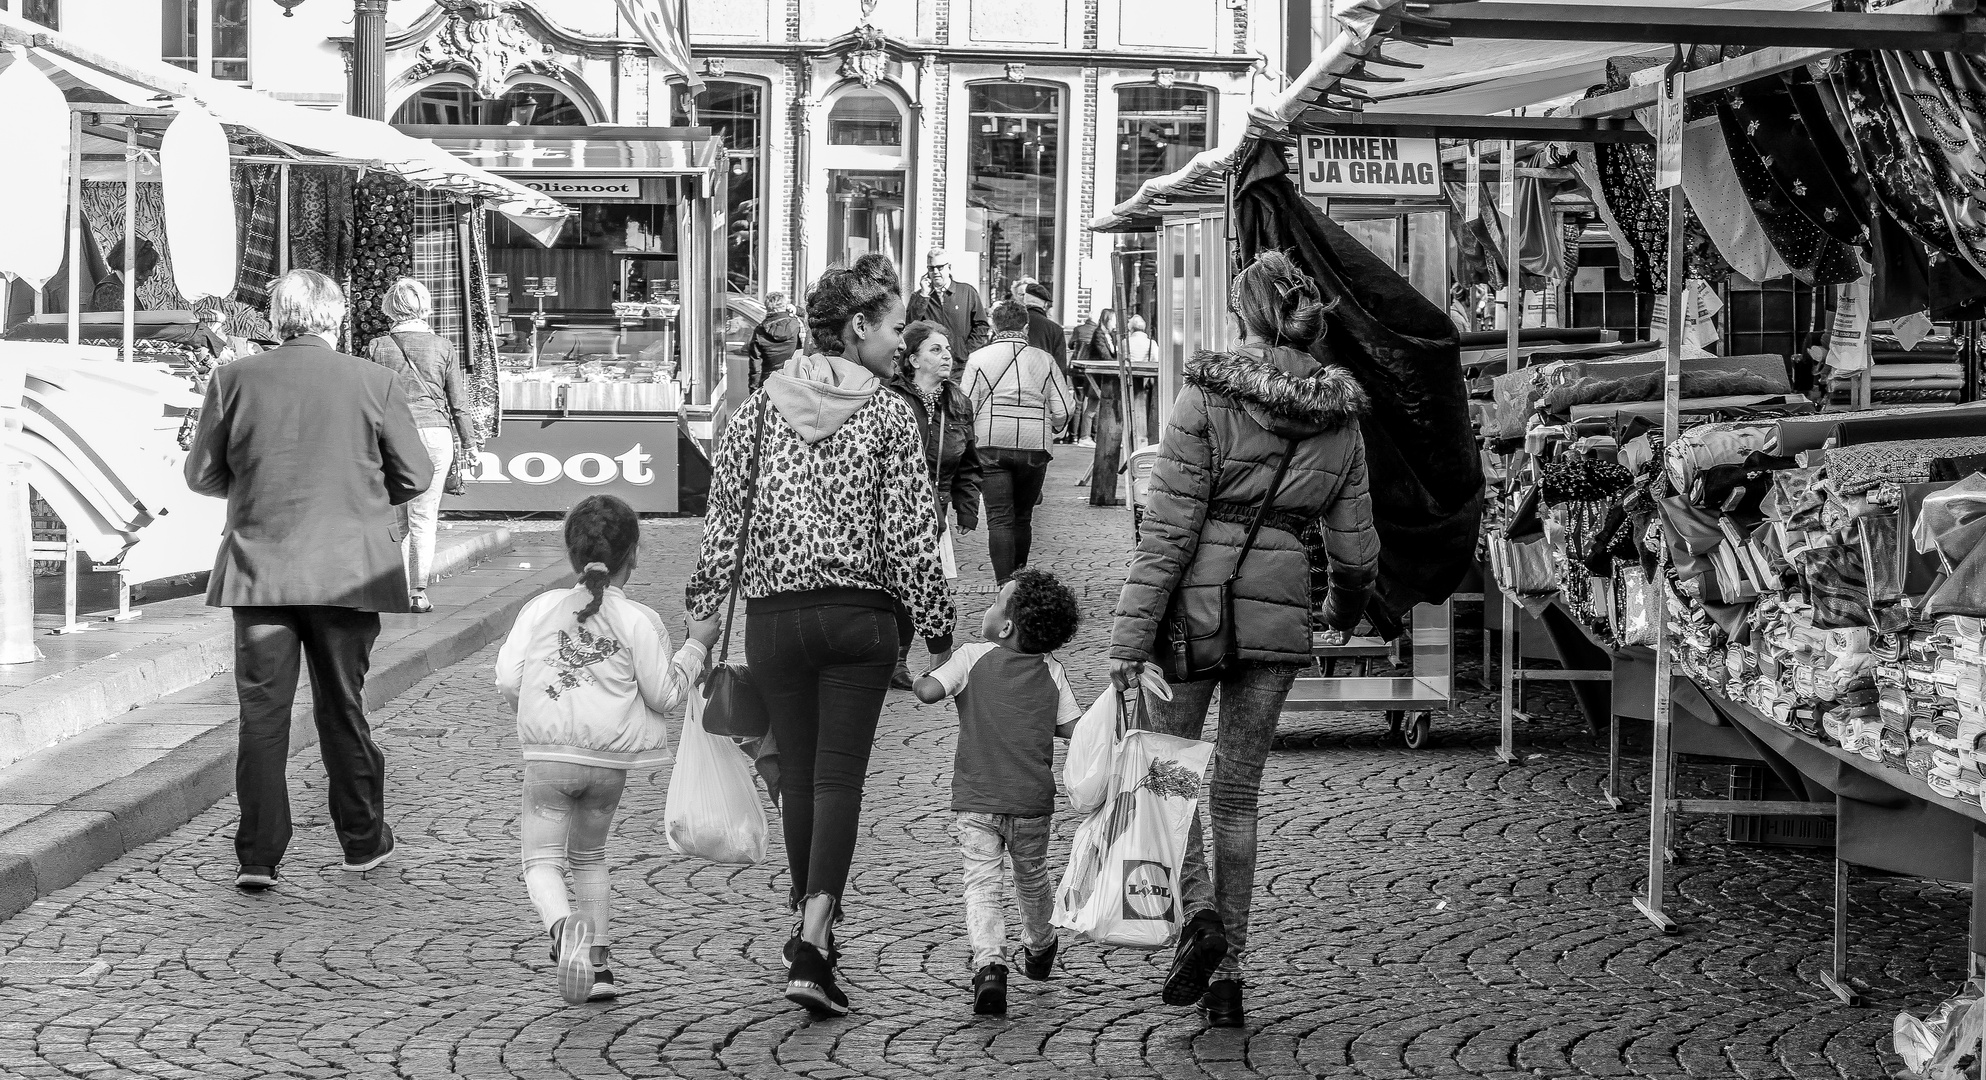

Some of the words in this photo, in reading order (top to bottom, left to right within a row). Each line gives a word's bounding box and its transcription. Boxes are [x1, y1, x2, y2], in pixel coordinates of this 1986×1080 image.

[1307, 138, 1398, 160] PINNEN
[1309, 161, 1342, 183] JA
[1349, 161, 1434, 185] GRAAG
[524, 182, 630, 192] Olienoot
